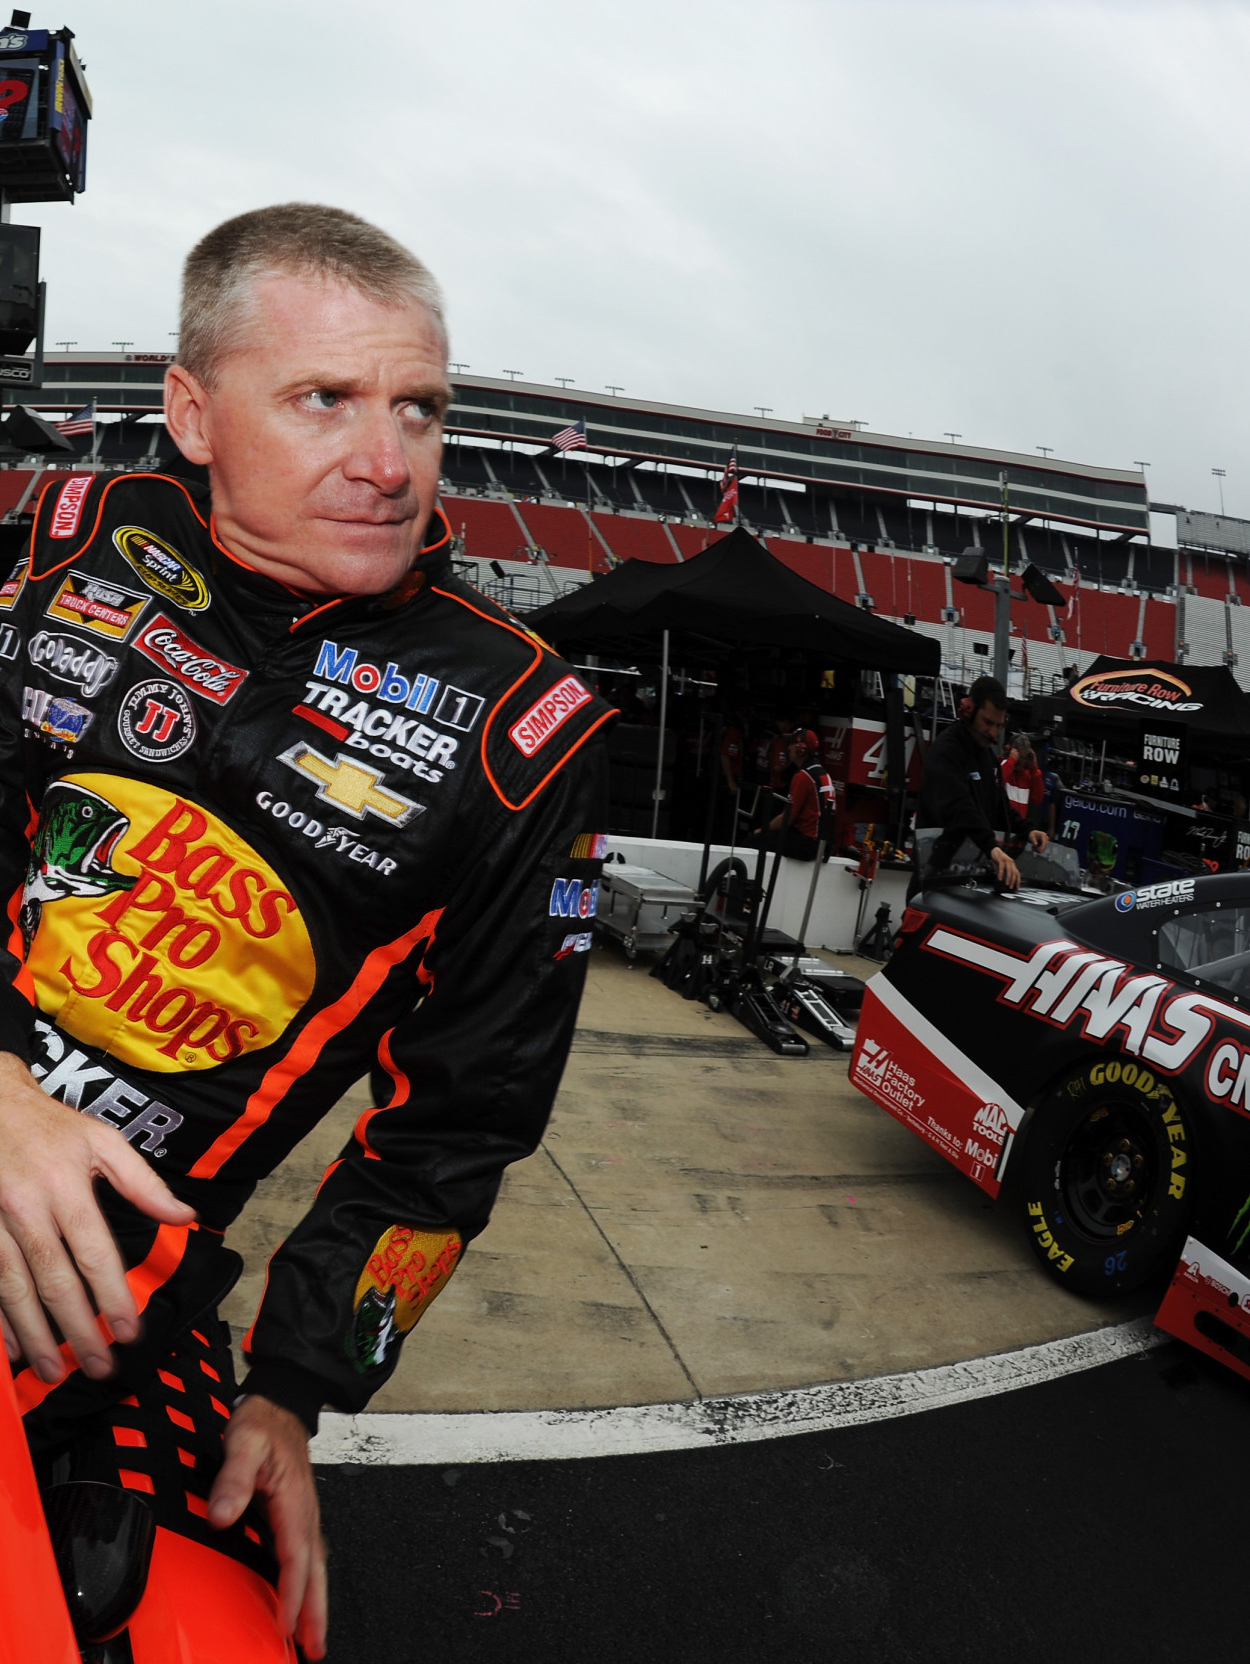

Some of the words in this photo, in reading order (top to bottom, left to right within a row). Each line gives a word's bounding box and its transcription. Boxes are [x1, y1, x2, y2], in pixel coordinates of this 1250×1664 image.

[816, 428, 832, 436] FOOD
[839, 431, 852, 439] CITY
[53, 476, 92, 536] SIMPSON
[142, 554, 178, 582] Sprint
[143, 545, 181, 571] NASCAR
[60, 594, 86, 610] TRUCK
[87, 604, 129, 625] CENTERS
[144, 627, 239, 697] Coca-Cola
[313, 640, 439, 713] Mobil
[1090, 679, 1148, 693] Furniture
[1148, 684, 1182, 701] Row
[1090, 690, 1204, 711] RACING
[129, 683, 168, 710] JIMMY
[168, 689, 192, 738] JOHN'S
[136, 699, 181, 742] JJ
[302, 681, 460, 769] TRACKER
[517, 676, 585, 750] SIMPSON
[122, 709, 141, 748] GOURMET
[138, 737, 188, 757] SANDWICHES
[1144, 733, 1180, 750] FURNITURE
[344, 731, 445, 784] boats
[1143, 746, 1180, 765] ROW
[1064, 794, 1127, 819] geico.com
[126, 798, 297, 940] Bass
[1136, 880, 1196, 902] state
[1136, 898, 1161, 910] WATER
[1159, 893, 1195, 908] HEATERS
[94, 867, 222, 970] Pro
[60, 930, 260, 1063] Shops
[926, 930, 1222, 1072] HAAS
[884, 1071, 926, 1107] Factory
[888, 1060, 916, 1086] Haas
[881, 1081, 914, 1111] Outlet
[927, 1115, 953, 1141] Thanks
[952, 1134, 963, 1149] to:
[972, 1121, 1004, 1146] TOOLS
[973, 1104, 1008, 1135] MAC
[965, 1138, 999, 1169] Mobi
[1028, 1202, 1075, 1273] EAGLE
[365, 1225, 414, 1290] Bass
[387, 1250, 426, 1300] Pro
[1210, 1279, 1231, 1297] BOSCH
